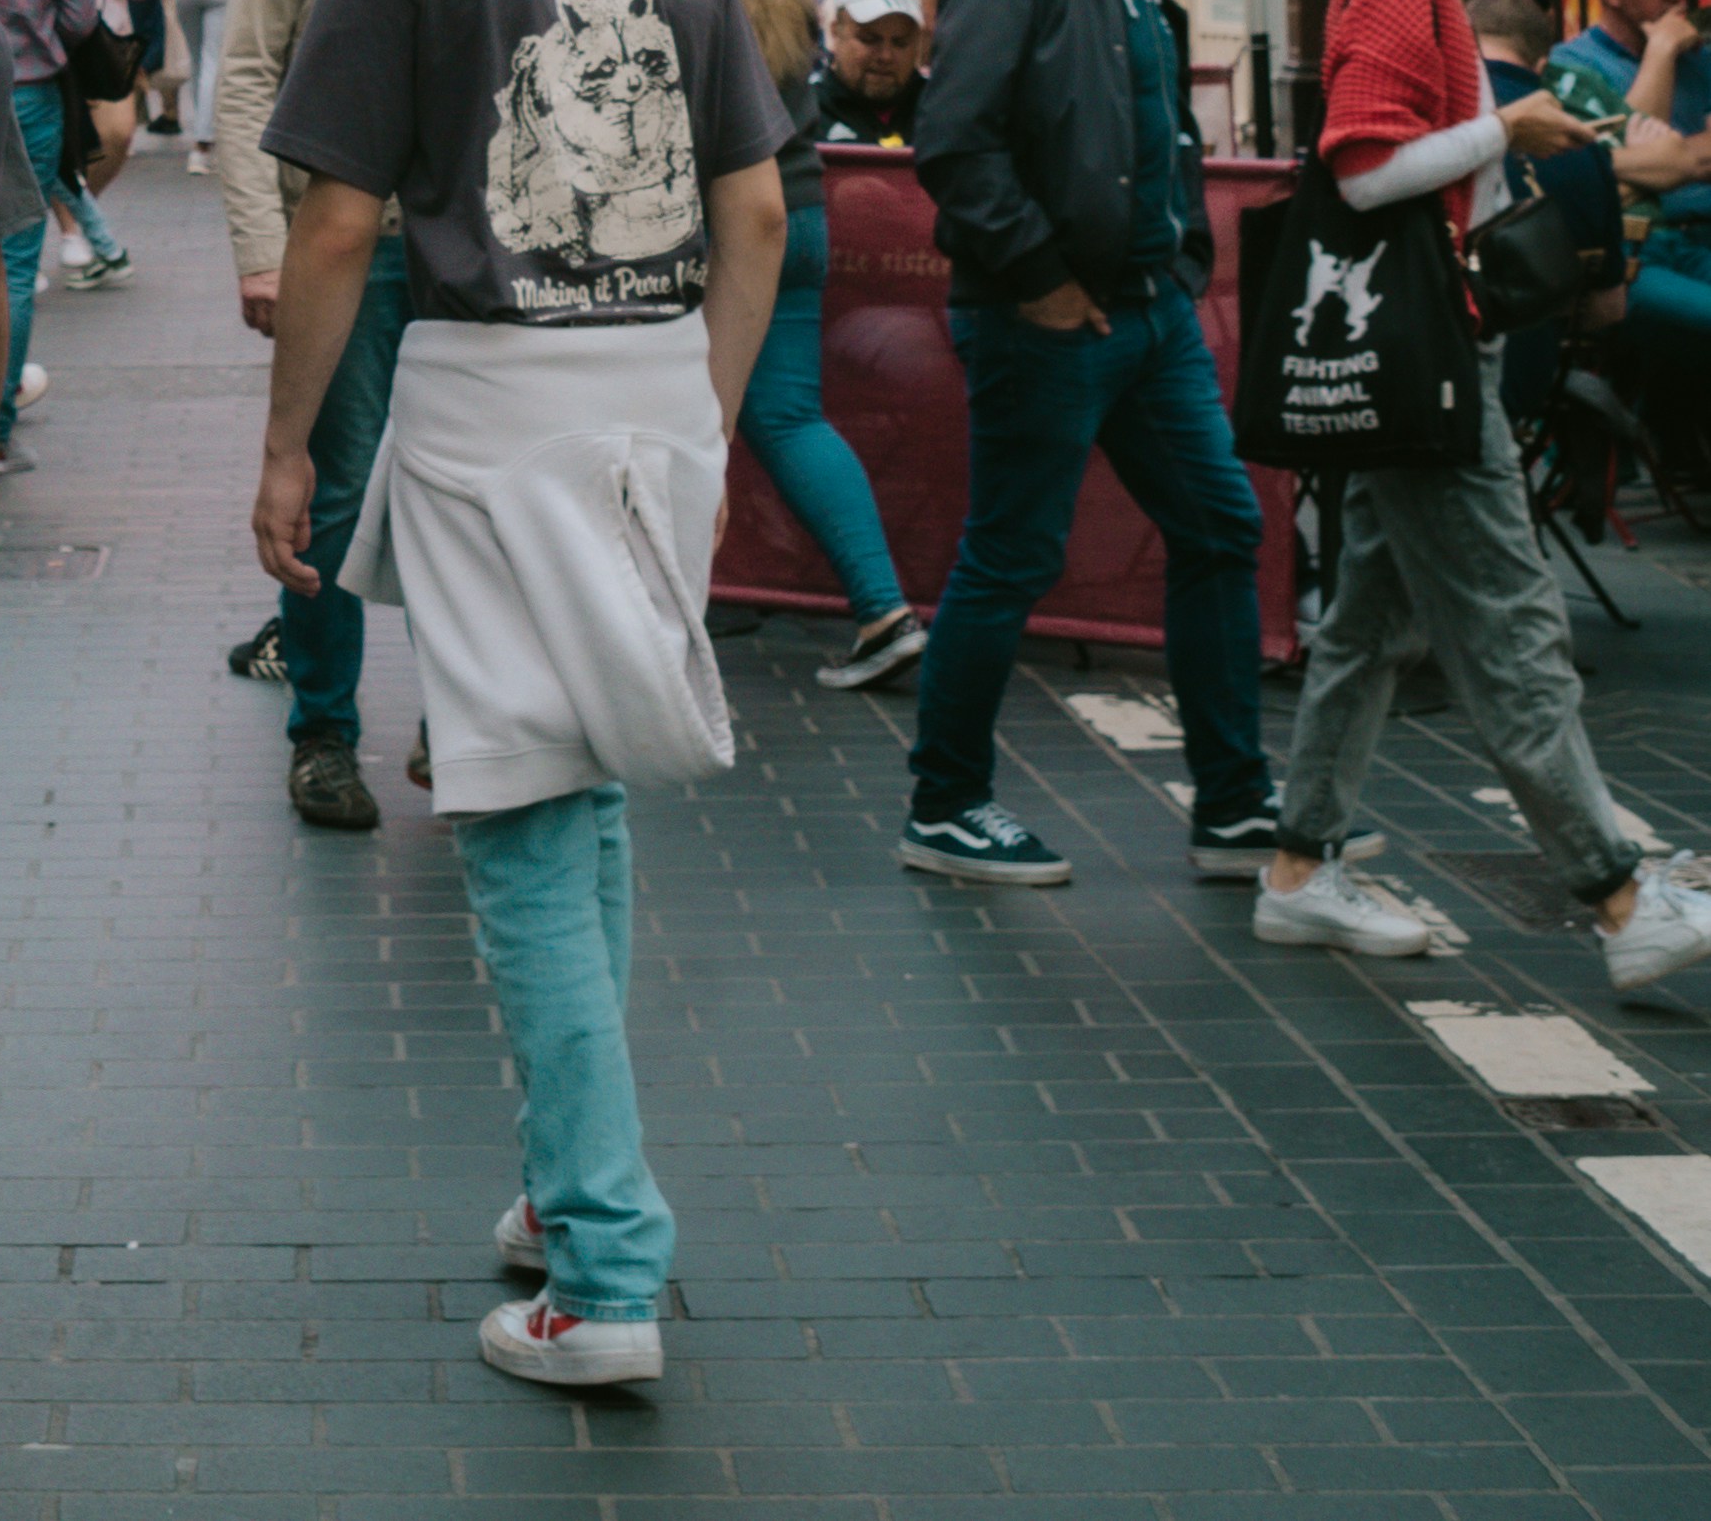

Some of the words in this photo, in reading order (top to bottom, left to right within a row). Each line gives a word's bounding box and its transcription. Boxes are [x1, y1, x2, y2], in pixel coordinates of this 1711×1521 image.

[511, 276, 593, 312] Making
[594, 274, 615, 303] it
[1285, 382, 1371, 407] ANIMAL
[1281, 409, 1379, 434] TESTING
